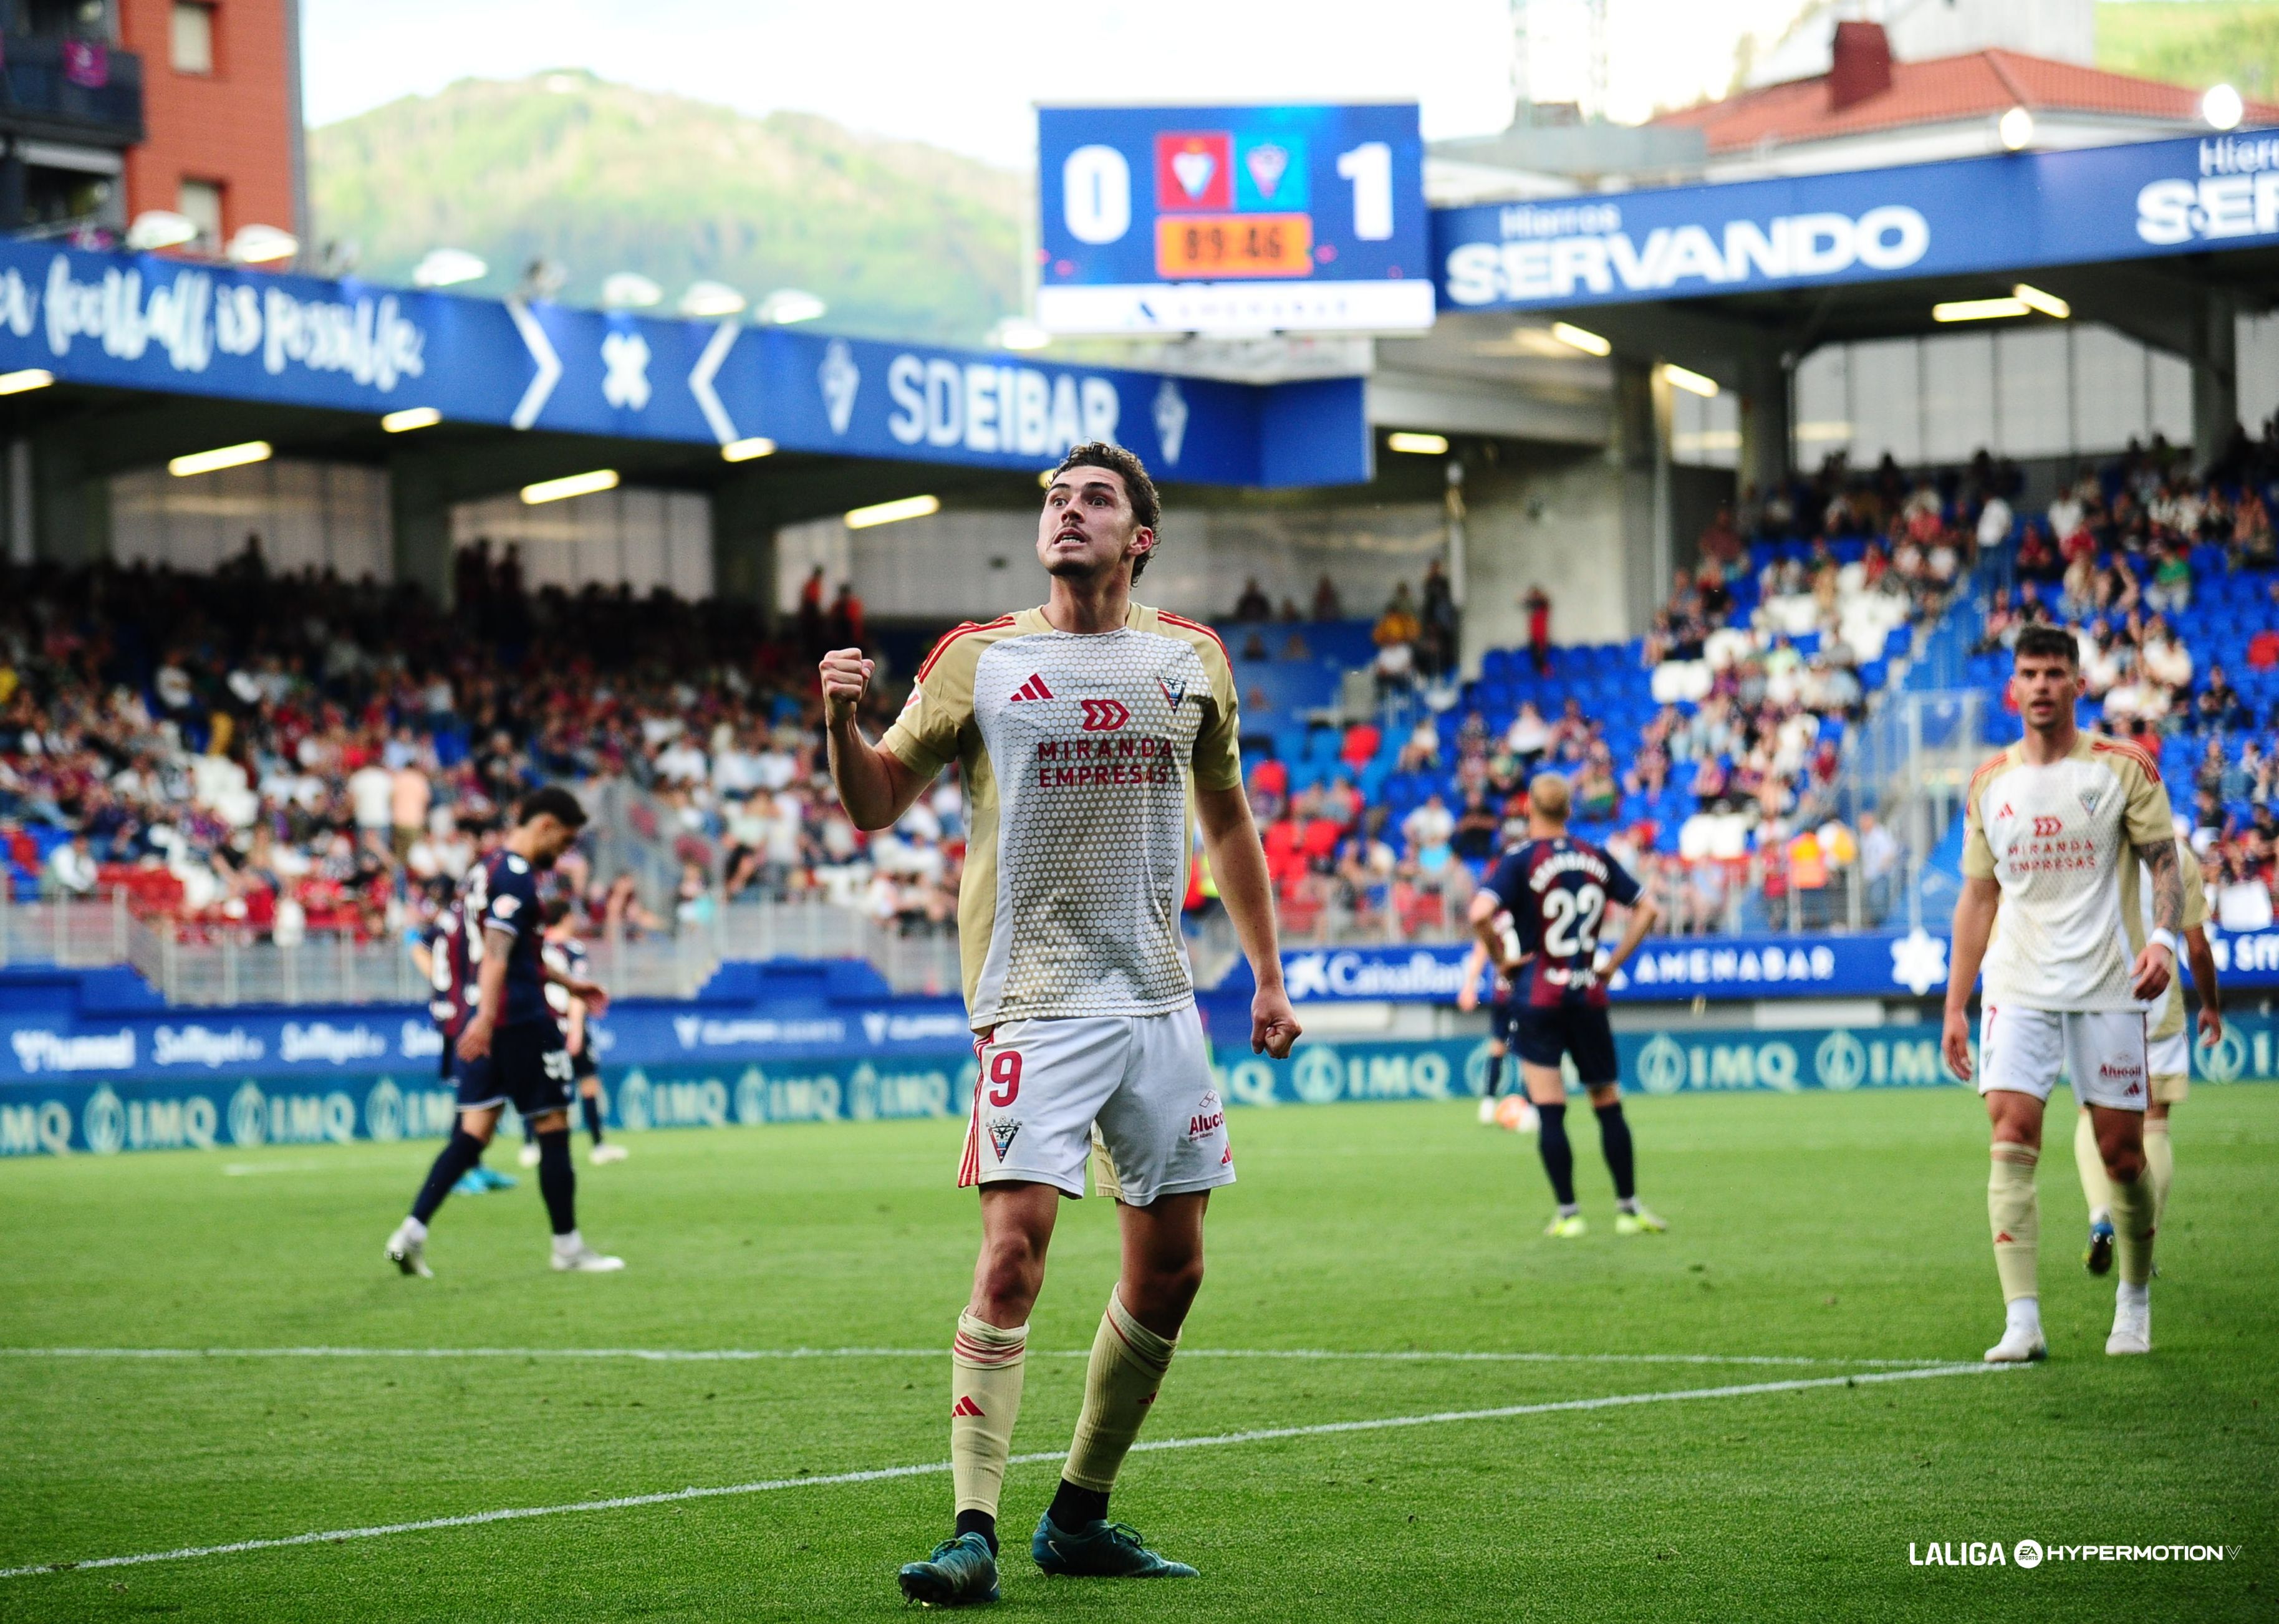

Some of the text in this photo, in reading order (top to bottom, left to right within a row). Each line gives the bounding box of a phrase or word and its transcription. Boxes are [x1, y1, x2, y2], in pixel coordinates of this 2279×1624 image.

[1064, 145, 1130, 244] 0
[1337, 142, 1394, 241] 1
[1447, 206, 1930, 305] SERVANDO
[1038, 738, 1172, 761] MIRANDA
[1039, 765, 1168, 787] EMPRESAS
[2008, 840, 2094, 856] MIRANDA
[2009, 855, 2096, 874] EMPRESAS
[1542, 883, 1607, 958] 22
[990, 1050, 1023, 1107] 9
[1347, 1055, 1455, 1100] IMQ
[1690, 1040, 1801, 1093] IMQ
[272, 1092, 357, 1145] IMQ
[407, 1091, 456, 1136] IM
[653, 1077, 728, 1128] IMQ
[771, 1071, 841, 1123] IMQ
[880, 1069, 949, 1120] IMQ
[129, 1095, 218, 1154] IMQ
